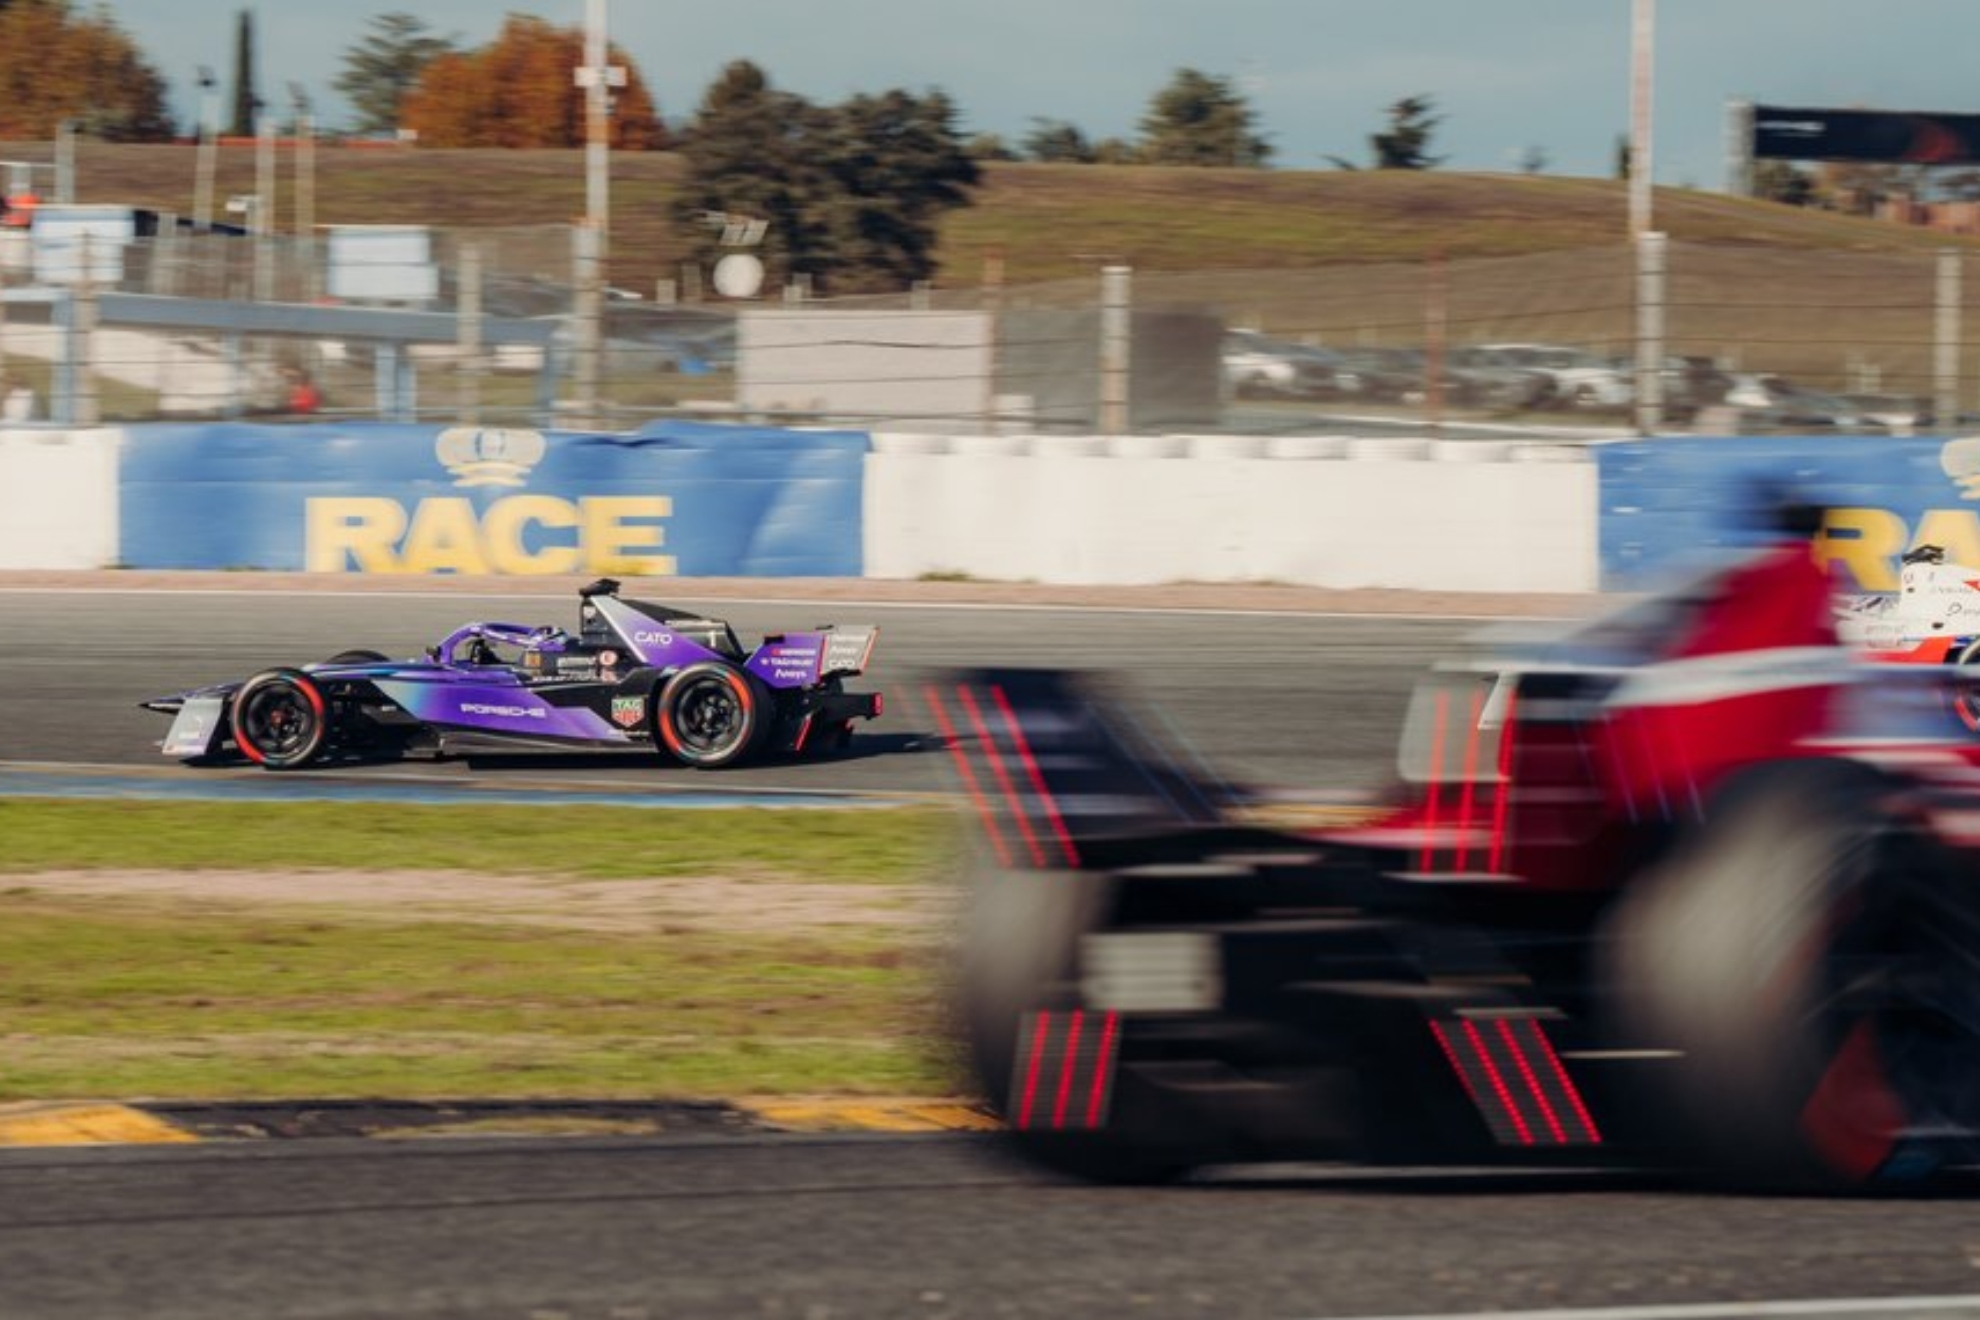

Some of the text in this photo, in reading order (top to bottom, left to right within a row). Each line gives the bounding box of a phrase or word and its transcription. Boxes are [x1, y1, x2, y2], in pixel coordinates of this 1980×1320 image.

[304, 494, 678, 576] RACE
[633, 630, 673, 646] CATO
[460, 702, 546, 719] PORSCHE
